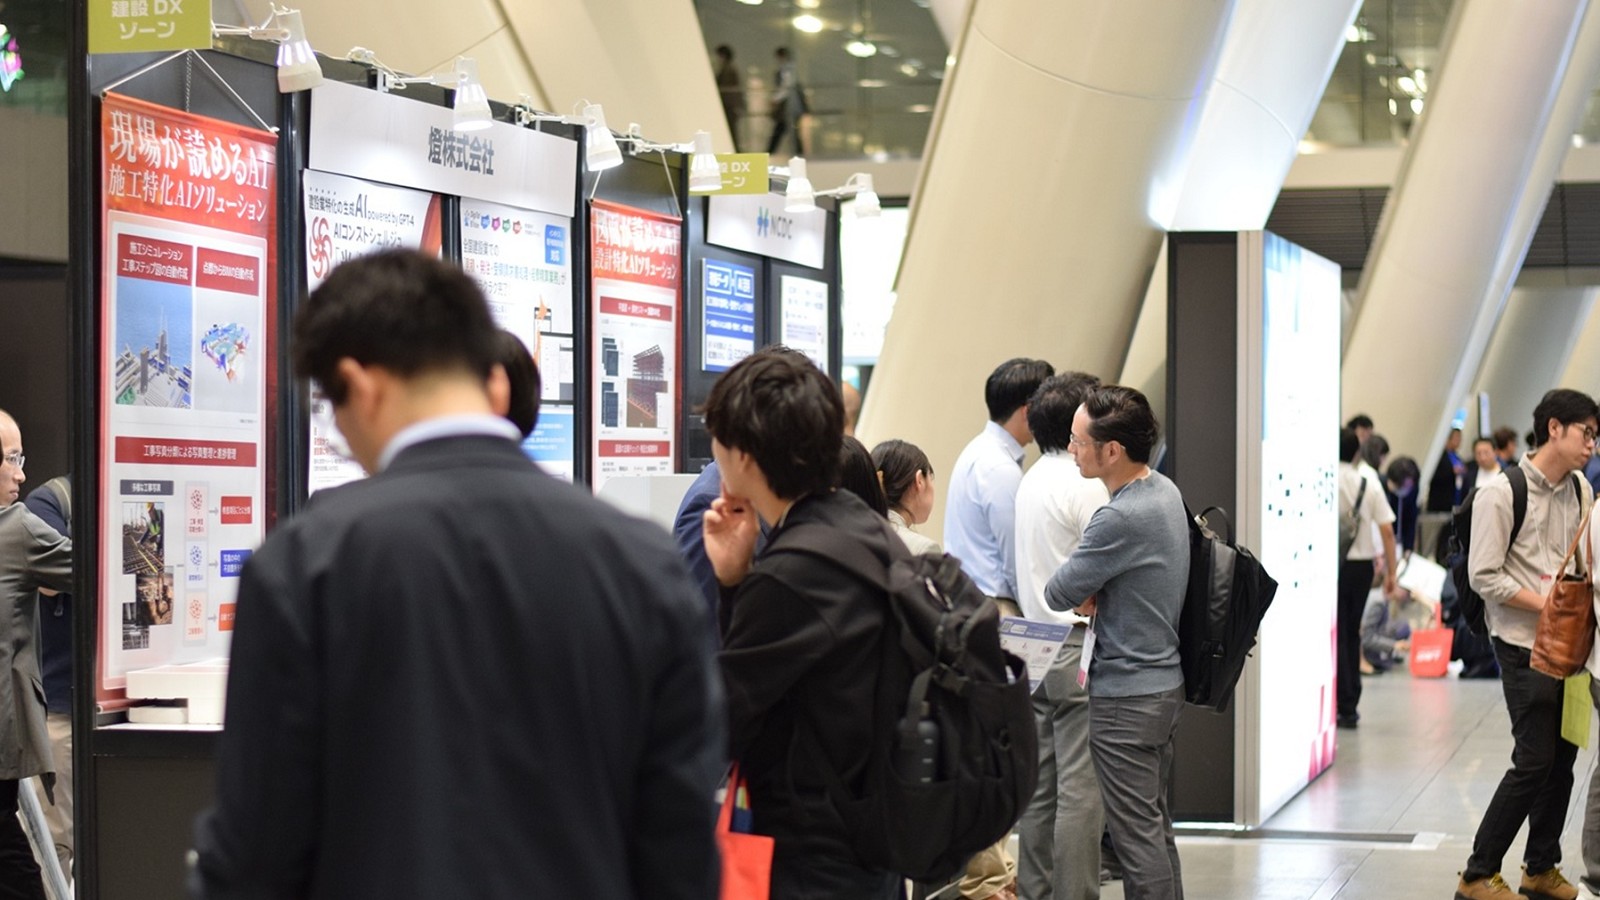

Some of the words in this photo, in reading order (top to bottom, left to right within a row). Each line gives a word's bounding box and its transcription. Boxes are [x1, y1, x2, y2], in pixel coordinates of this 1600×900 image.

[112, 0, 149, 17] 建設
[154, 0, 183, 15] DX
[109, 110, 270, 190] 現場が読めるAI
[428, 126, 495, 175] 燈株式会社
[721, 177, 746, 188] ーン
[731, 162, 750, 173] DX
[108, 163, 268, 222] 施工特化AIソリューション
